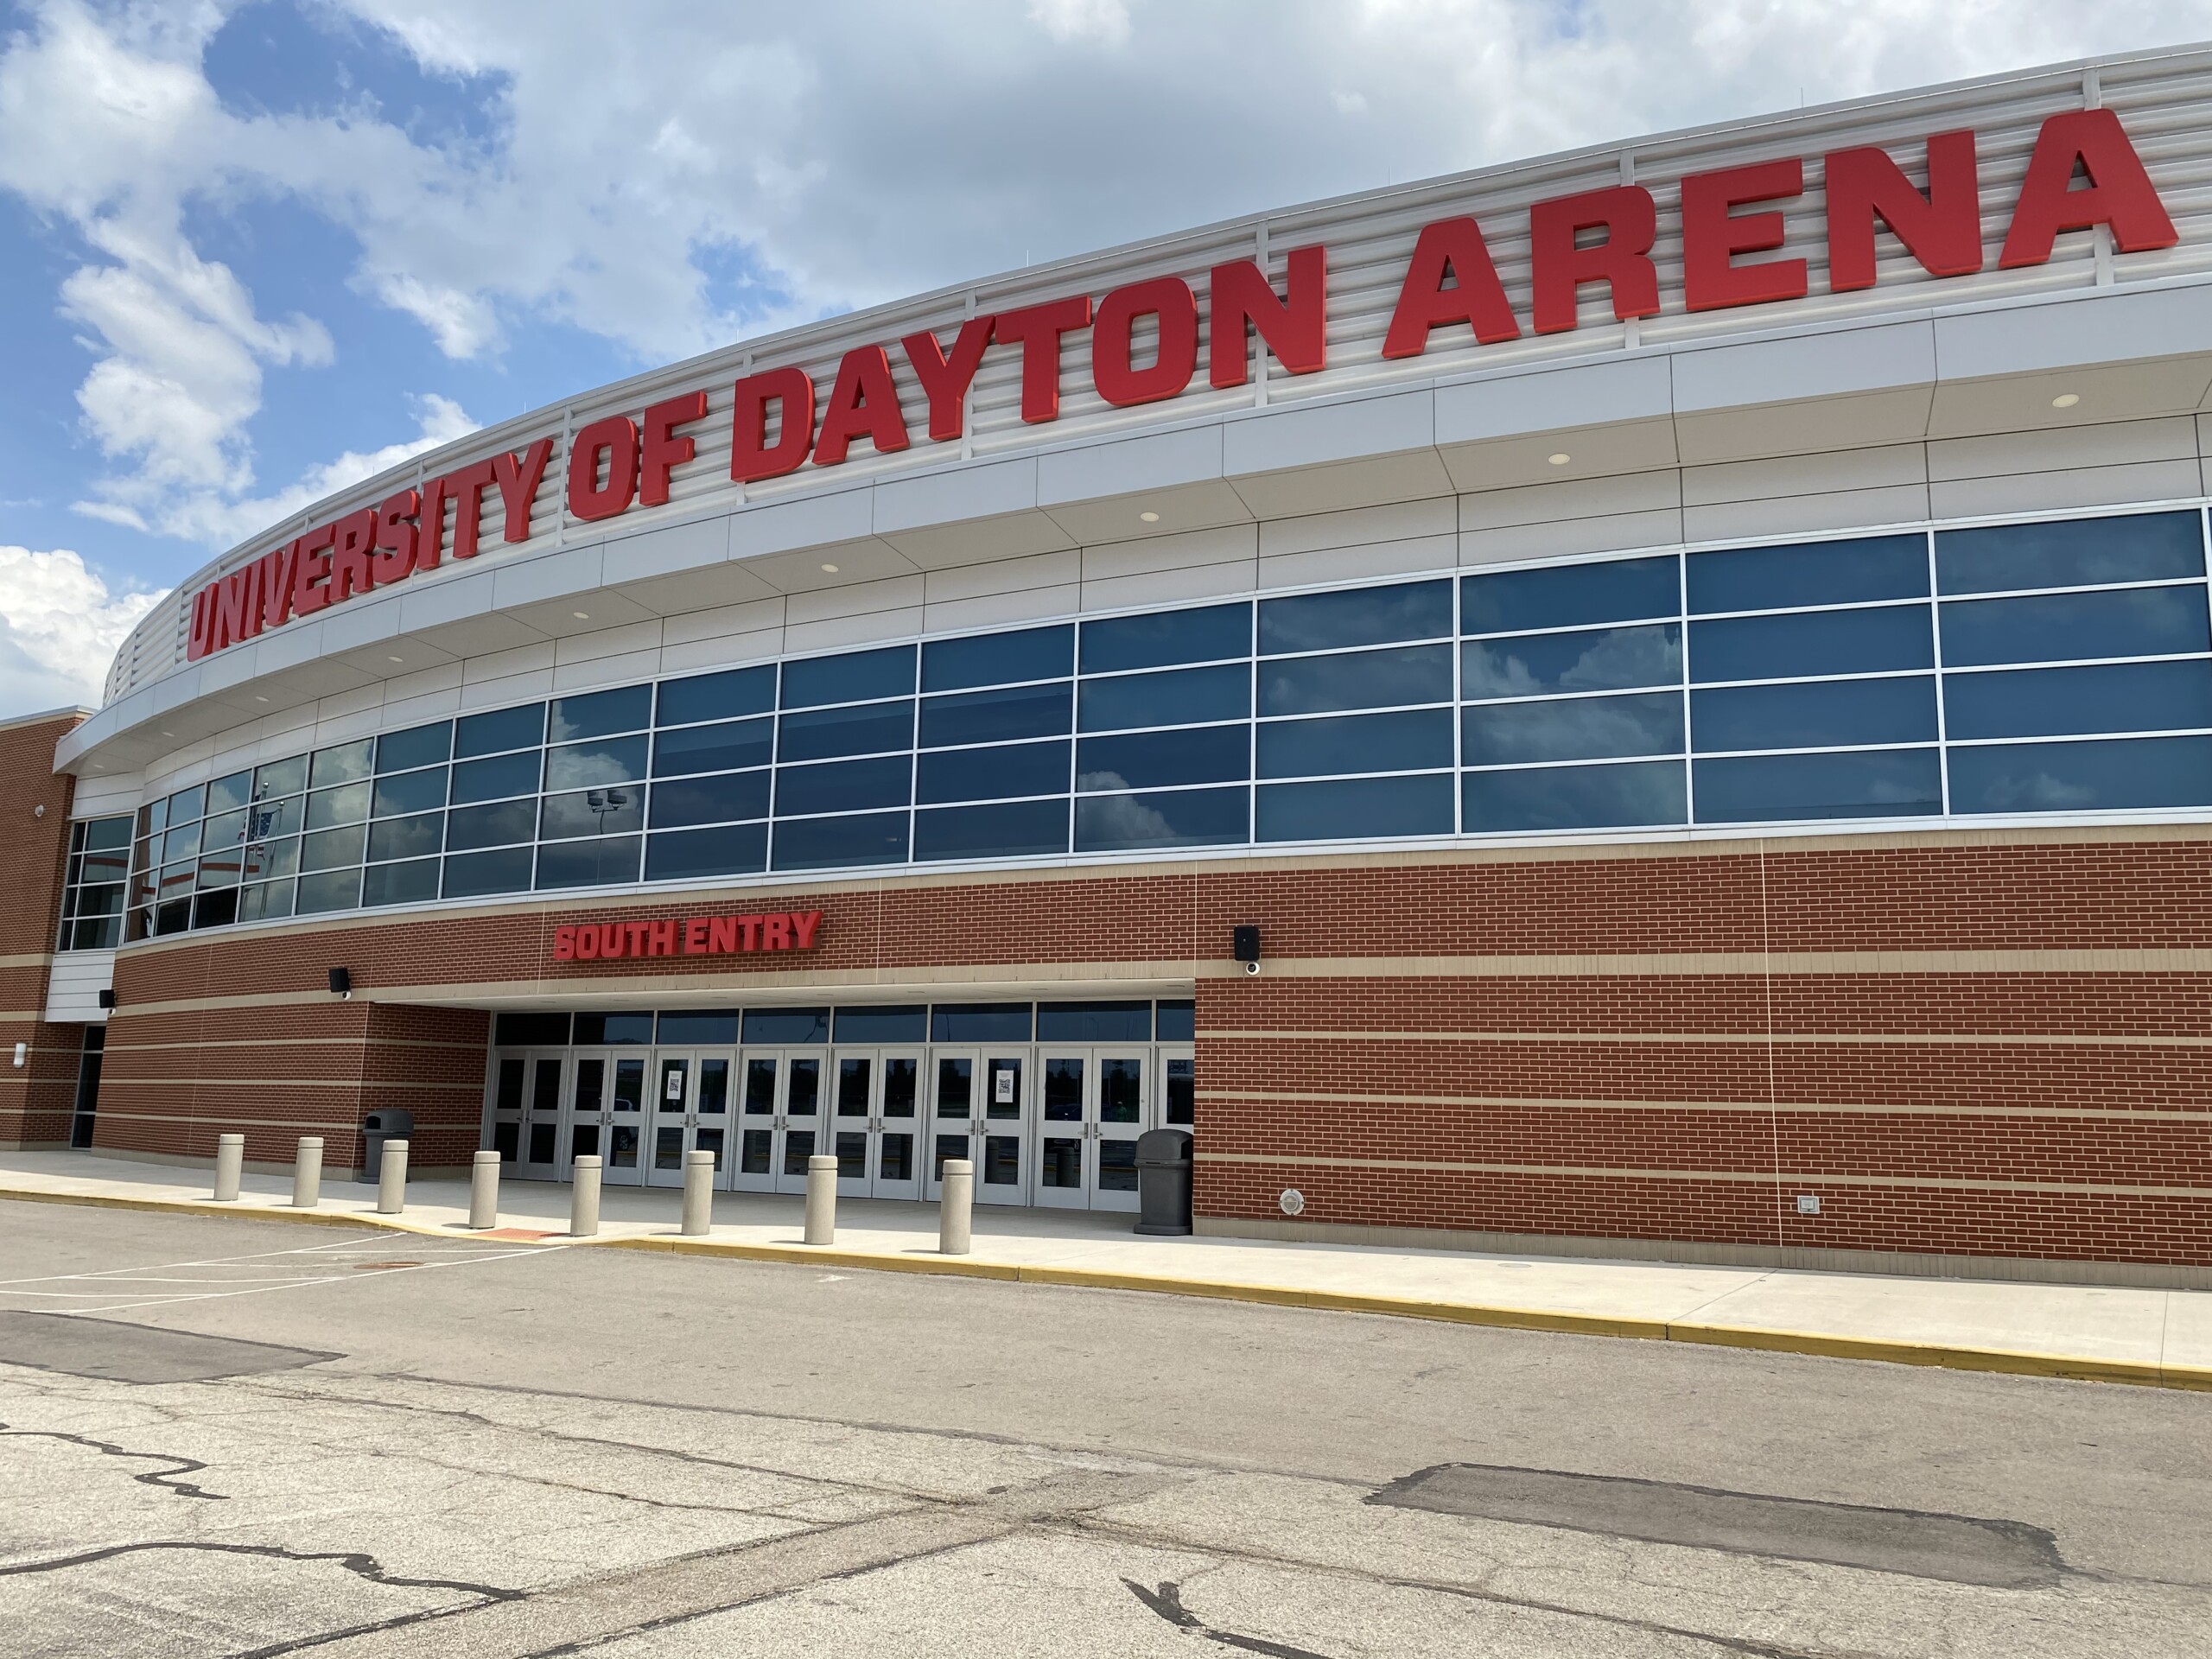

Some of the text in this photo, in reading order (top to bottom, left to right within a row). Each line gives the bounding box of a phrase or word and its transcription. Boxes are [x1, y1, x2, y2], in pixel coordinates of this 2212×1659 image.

[188, 110, 2177, 663] UNIVERSITY OF DAYTON ARENA
[554, 910, 824, 960] SOUTH ENTRY
